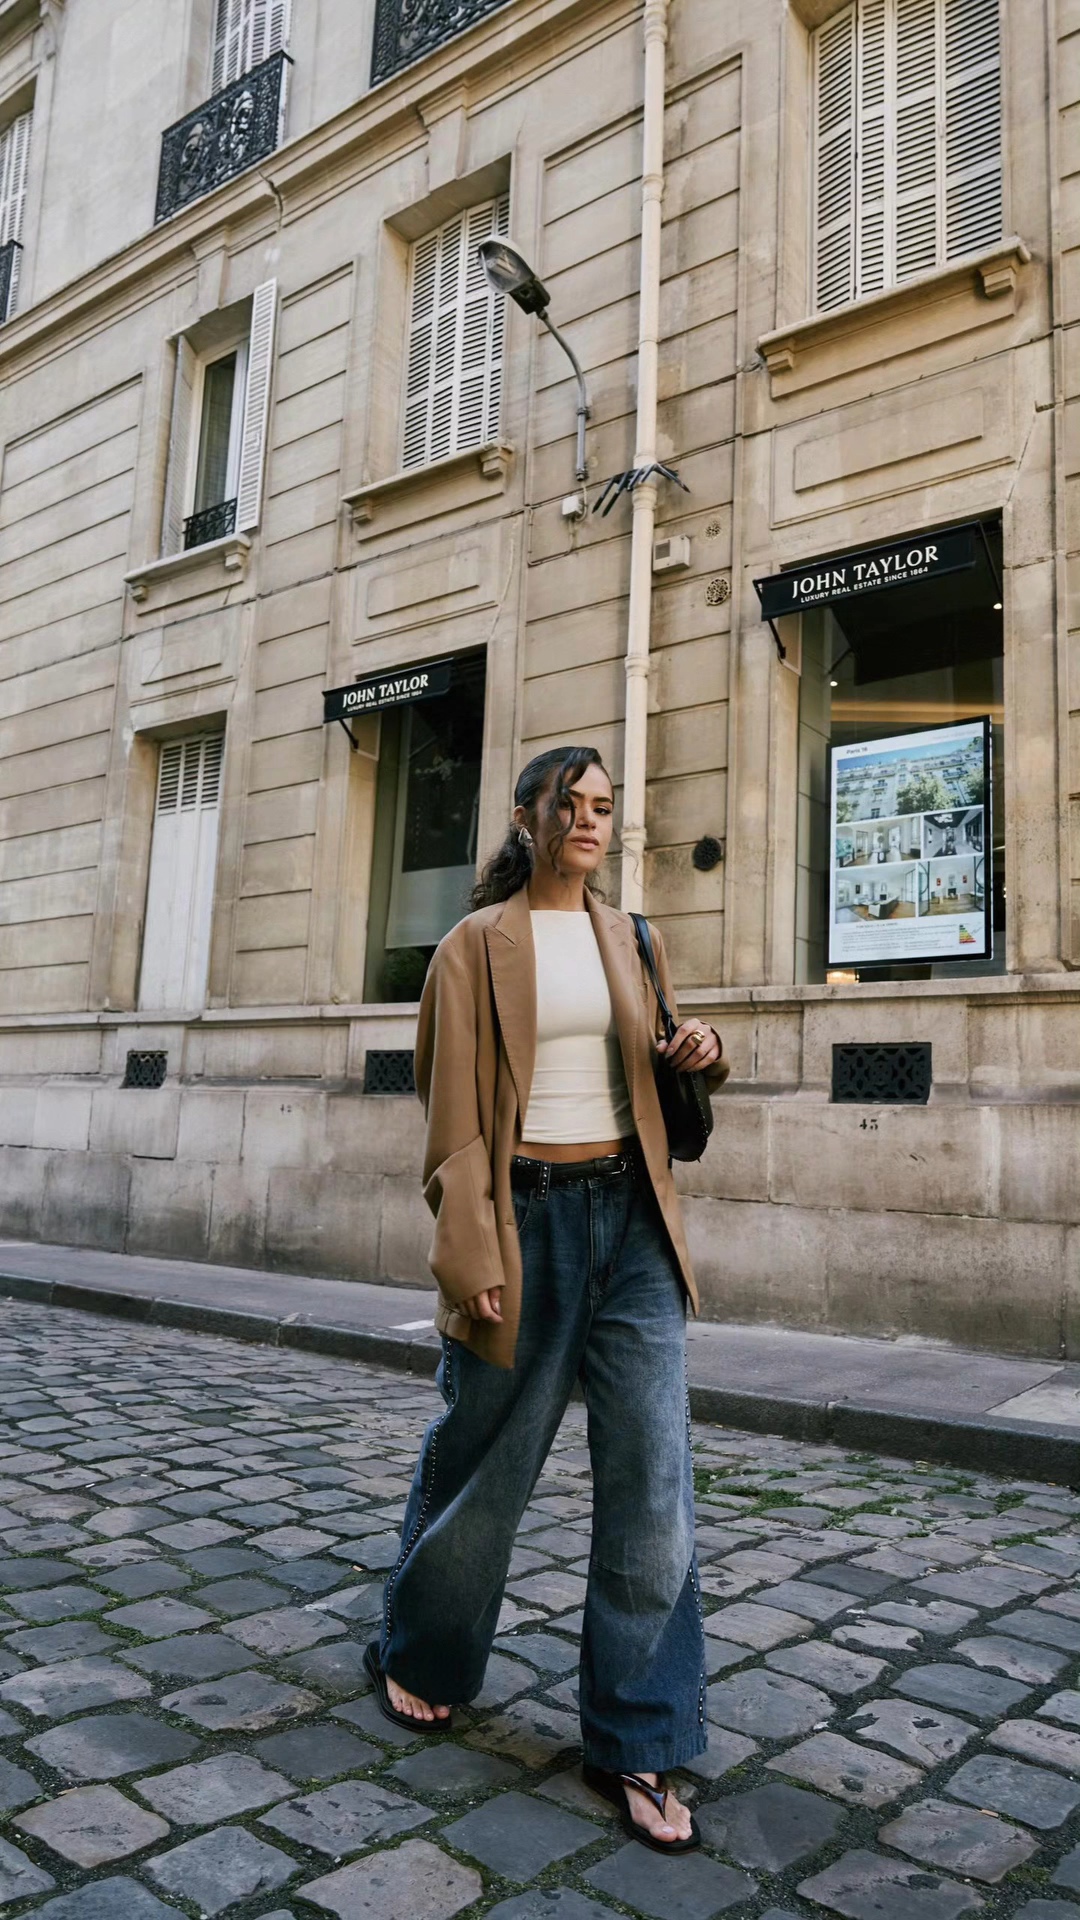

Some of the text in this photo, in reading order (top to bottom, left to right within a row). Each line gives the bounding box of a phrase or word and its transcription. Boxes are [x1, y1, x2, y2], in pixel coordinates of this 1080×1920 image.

[792, 545, 939, 598] JOHN TAYLOR
[801, 566, 929, 603] LUXURY REAL ESTATE SINCE 1864
[342, 674, 429, 708] JOHN TAYLOR
[365, 700, 377, 708] REAL
[378, 697, 395, 705] ESTATE
[396, 693, 410, 701] SINCE
